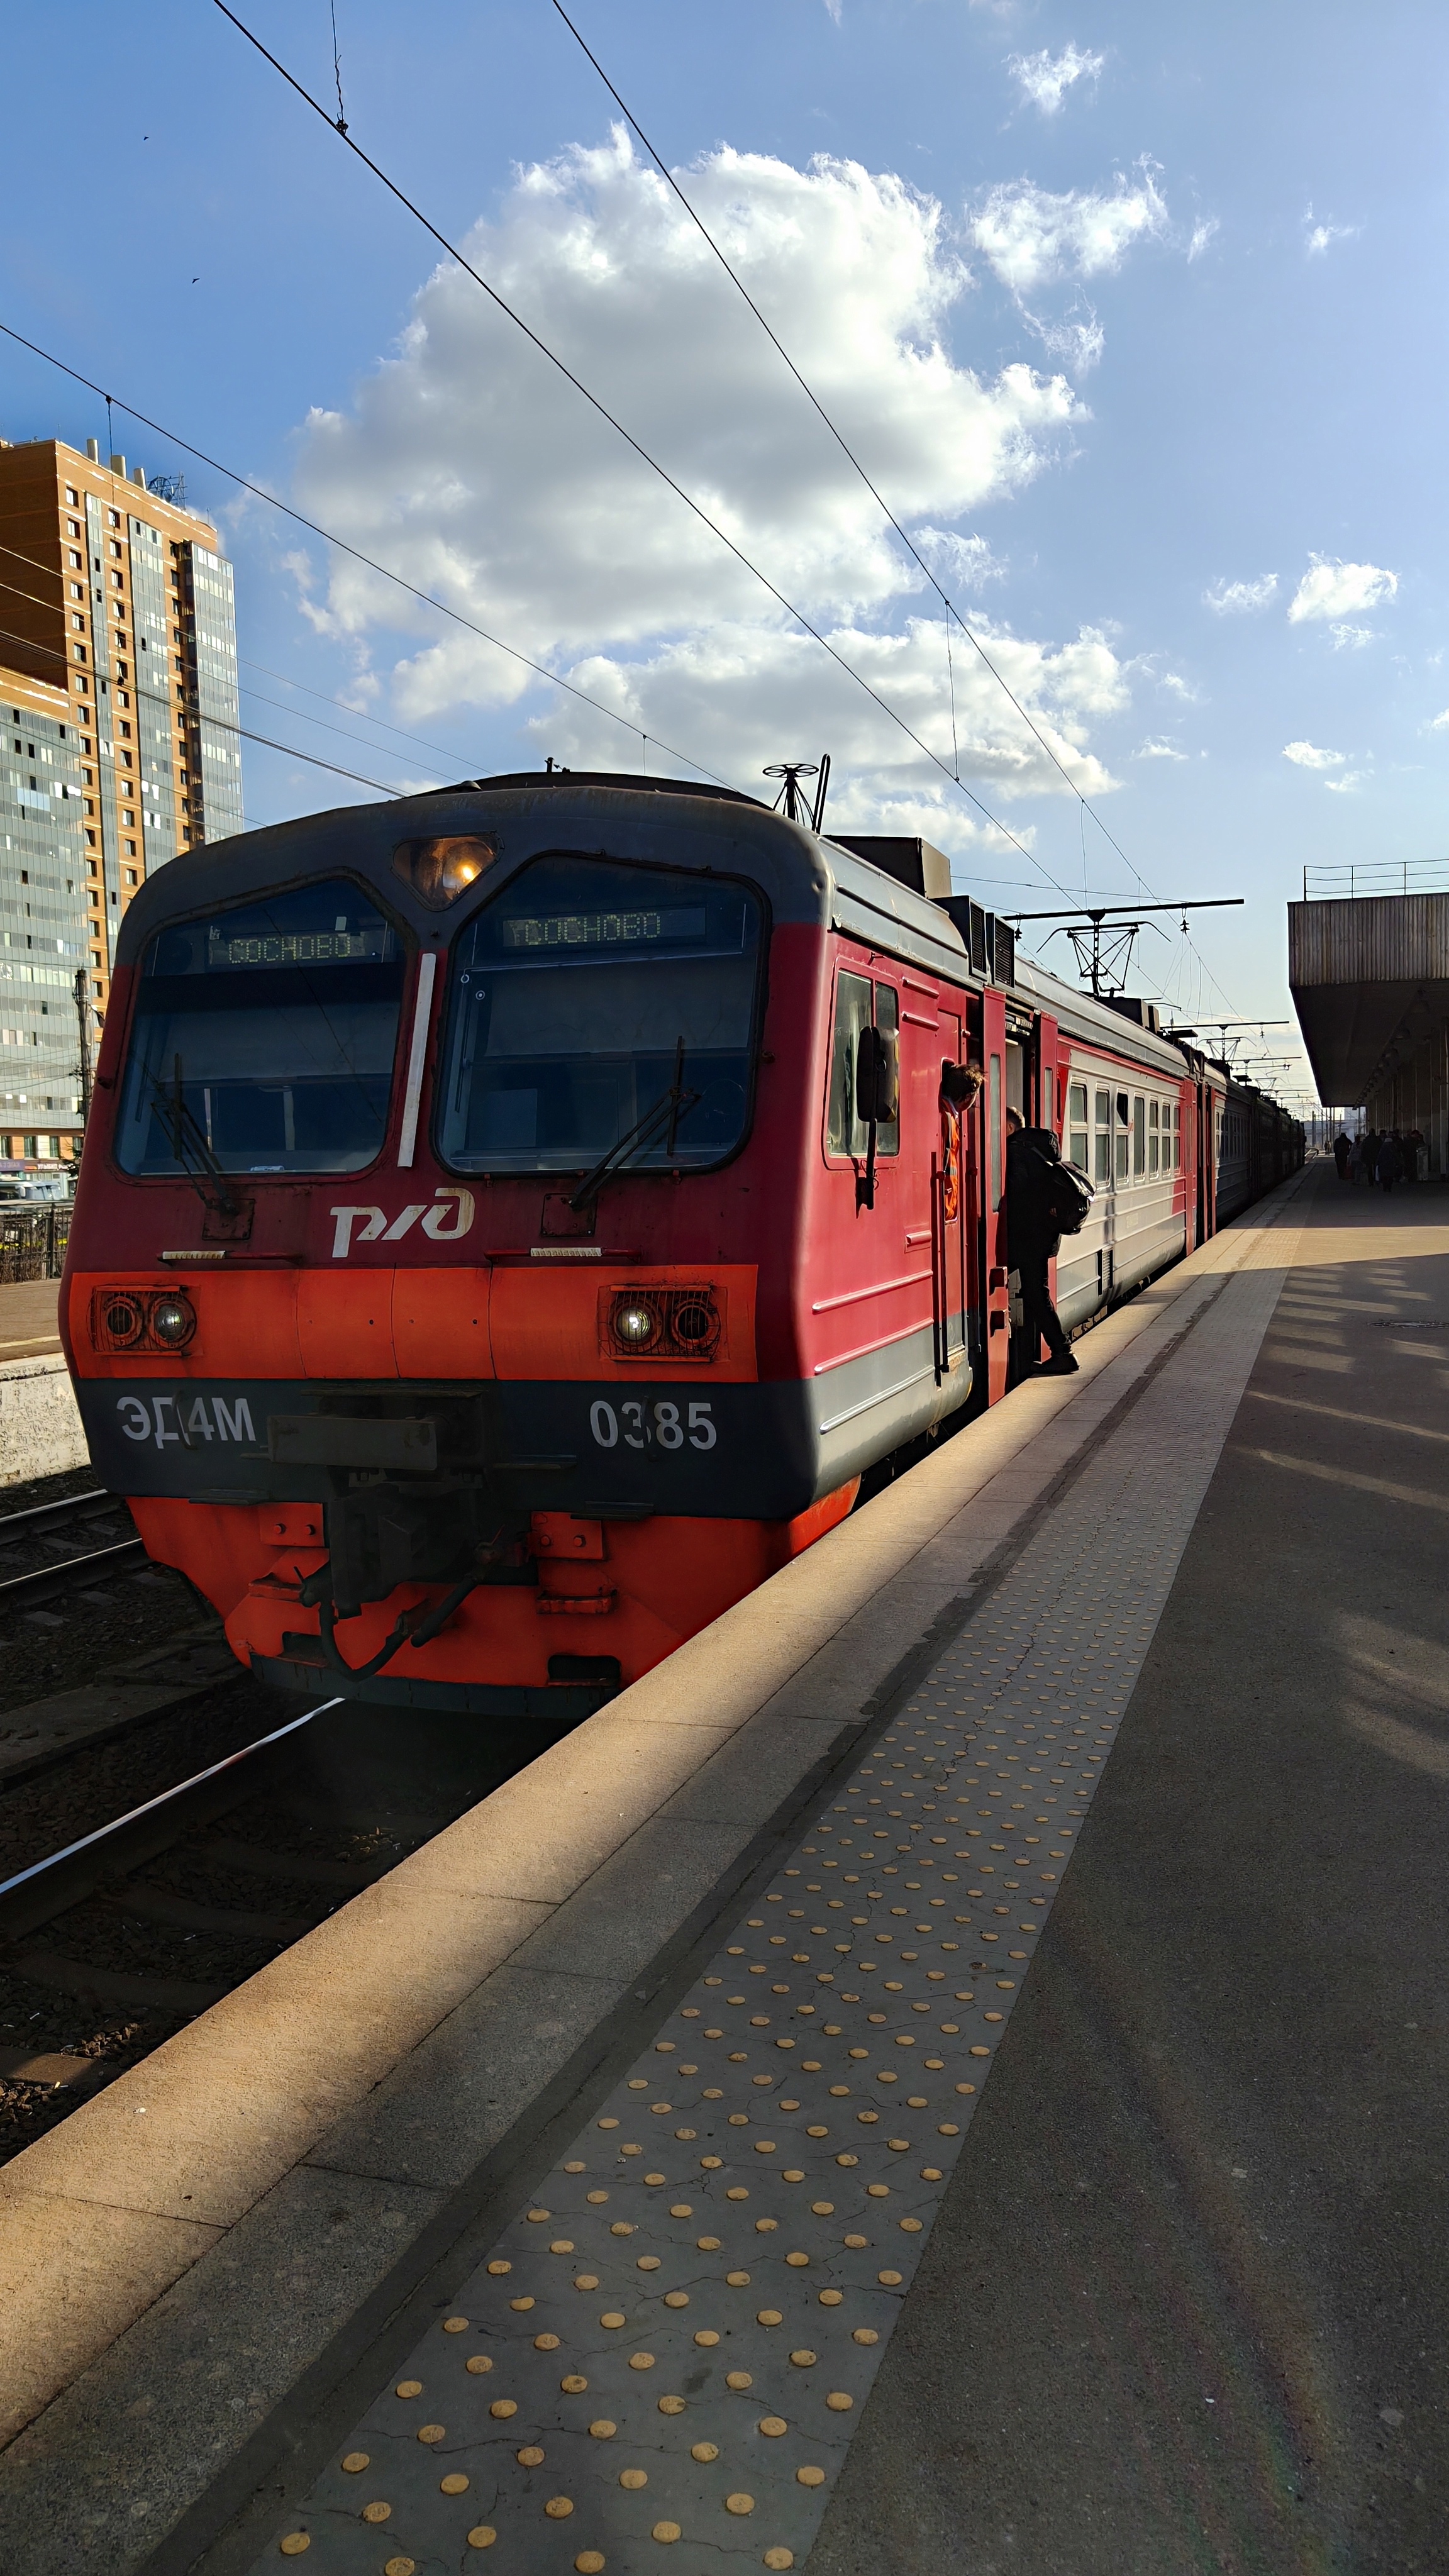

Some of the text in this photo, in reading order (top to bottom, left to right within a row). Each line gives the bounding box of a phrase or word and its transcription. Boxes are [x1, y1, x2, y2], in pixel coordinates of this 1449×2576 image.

[229, 935, 350, 963] СОСНОВО
[525, 913, 660, 945] СОСНОВО
[116, 1396, 257, 1449] ЭД4М
[590, 1401, 717, 1450] 0385
